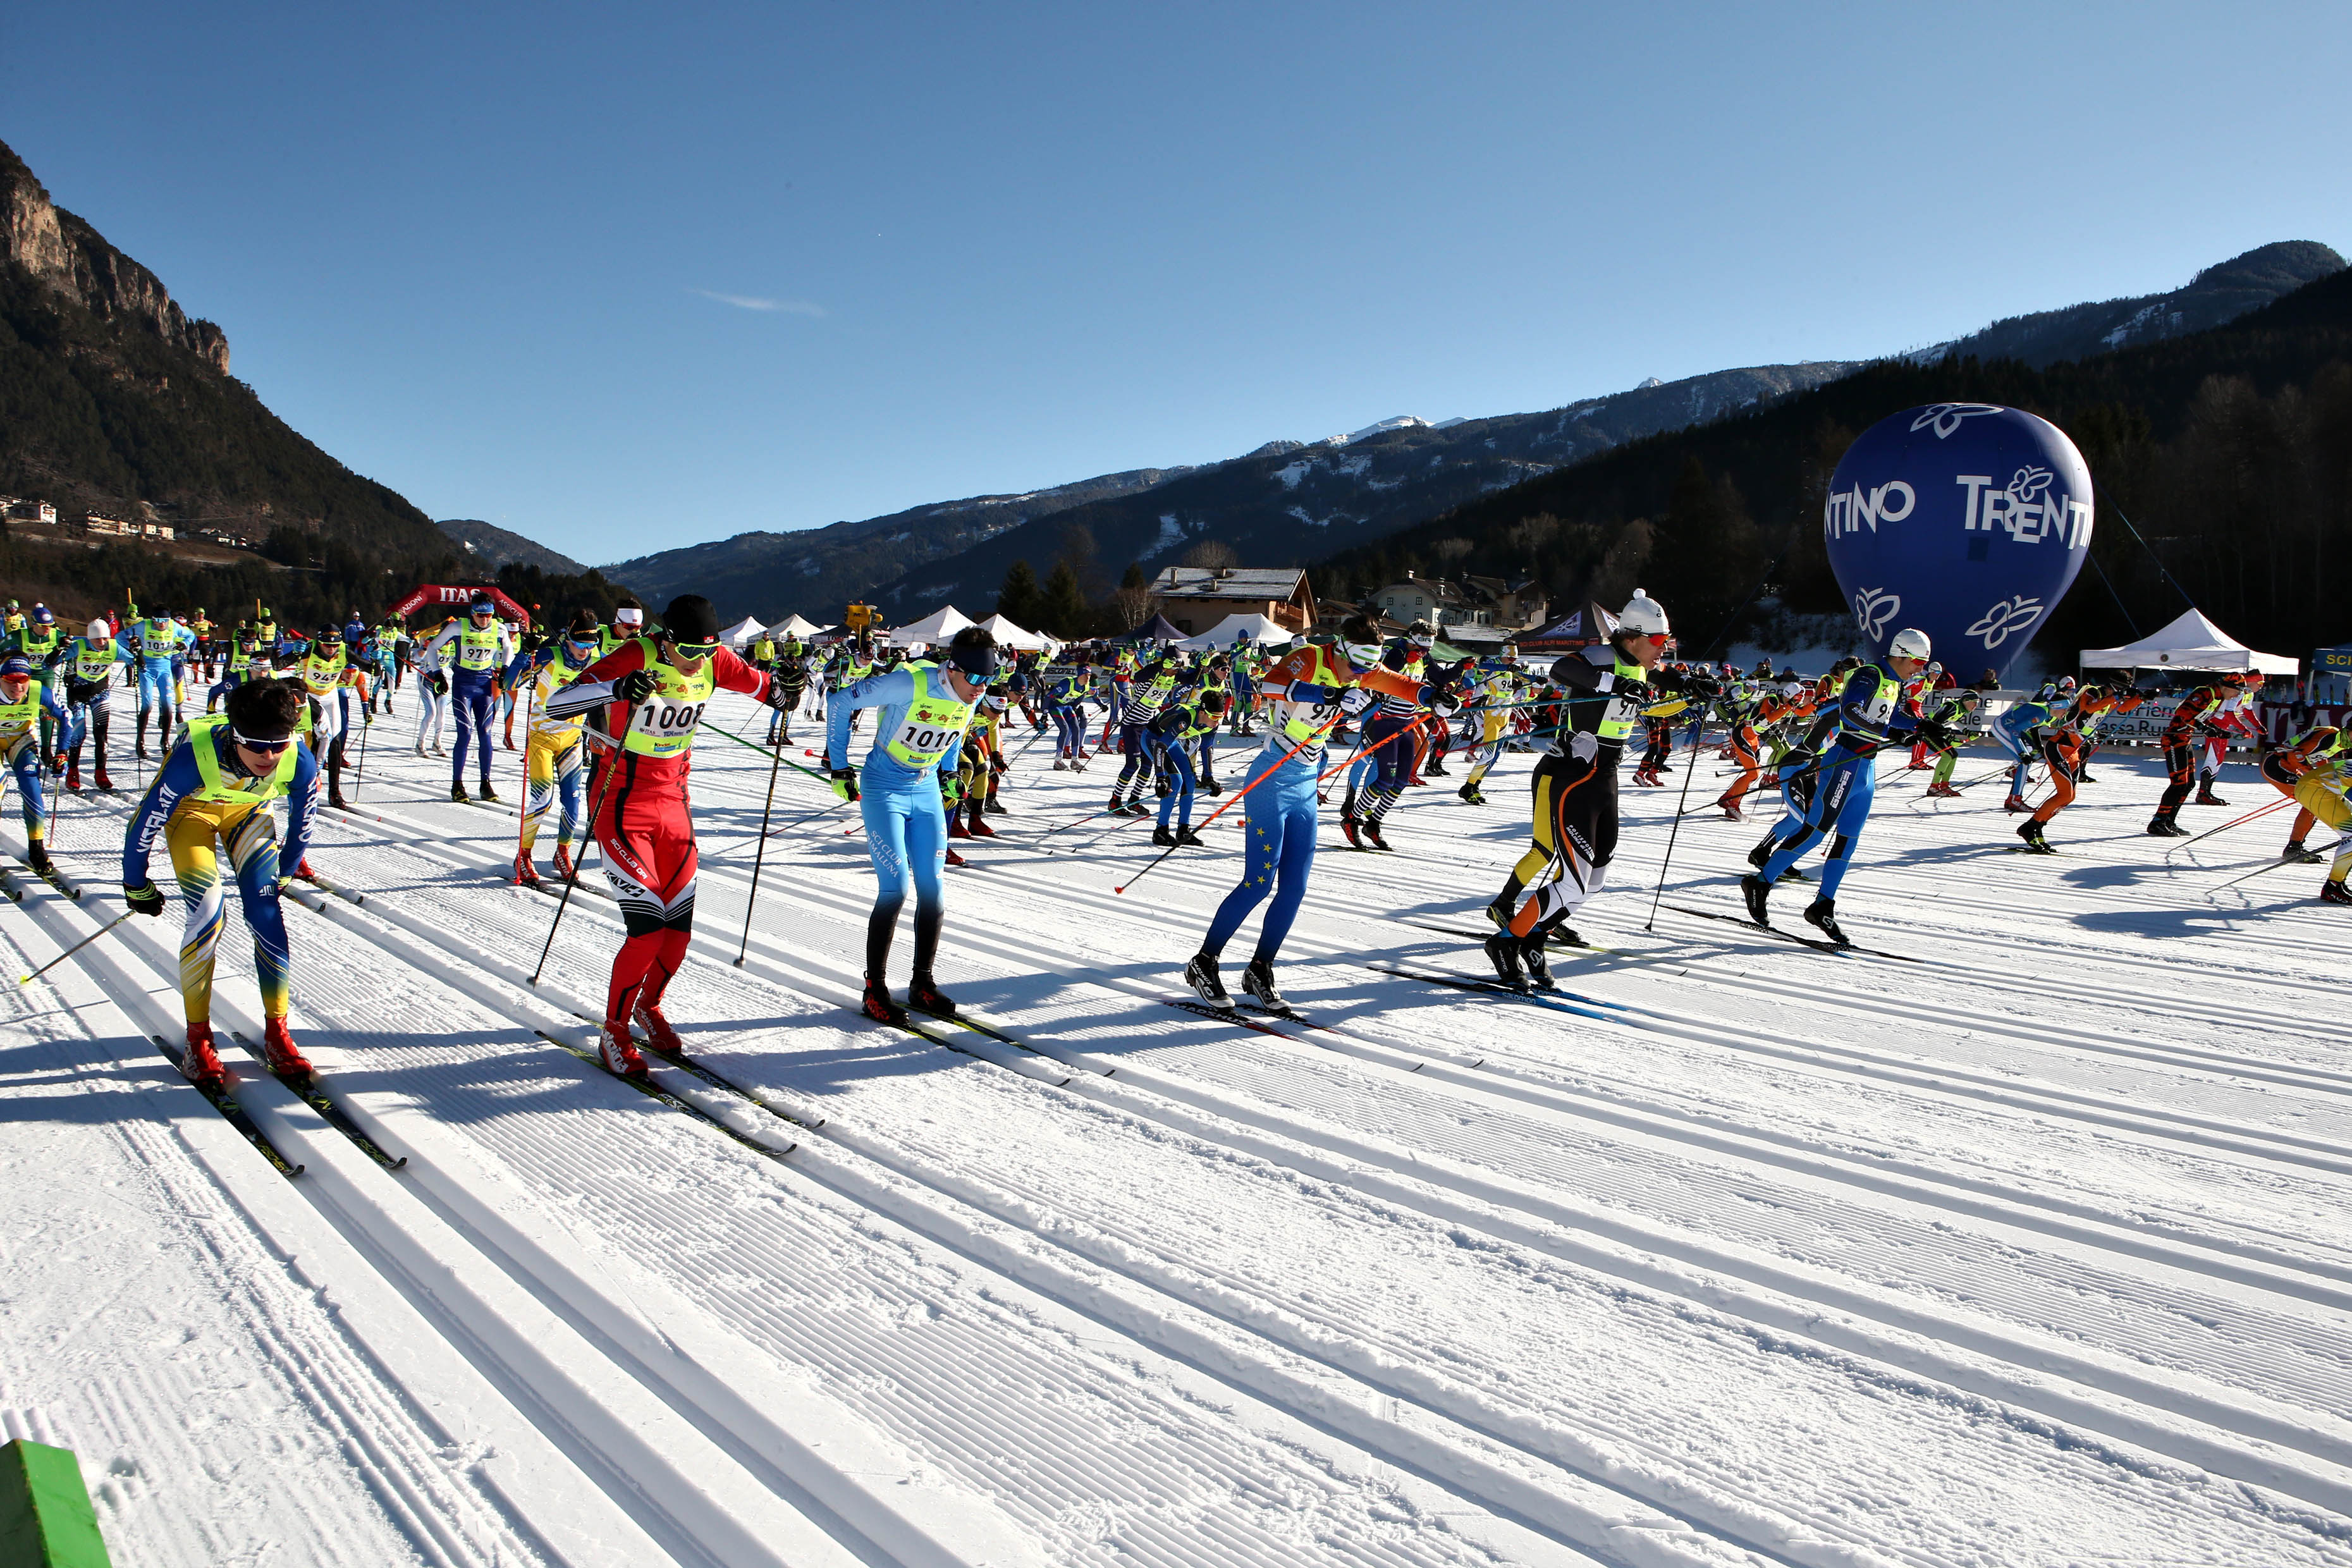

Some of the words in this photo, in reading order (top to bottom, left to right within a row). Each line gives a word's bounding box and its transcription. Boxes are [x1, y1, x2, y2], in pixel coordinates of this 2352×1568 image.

[439, 587, 481, 603] ITAS
[467, 648, 491, 659] 977
[2325, 654, 2352, 666] SCI
[312, 672, 339, 682] 945
[644, 702, 706, 730] 1008
[2266, 706, 2352, 743] ITA
[905, 726, 960, 749] 1010
[610, 838, 622, 851] SCI
[618, 849, 638, 868] CLUB
[867, 835, 900, 878] RIMALUNA
[871, 830, 883, 845] SCI
[881, 844, 903, 866] CLUB
[1502, 991, 1536, 1005] salomon
[1172, 1003, 1248, 1027] MADSHUS
